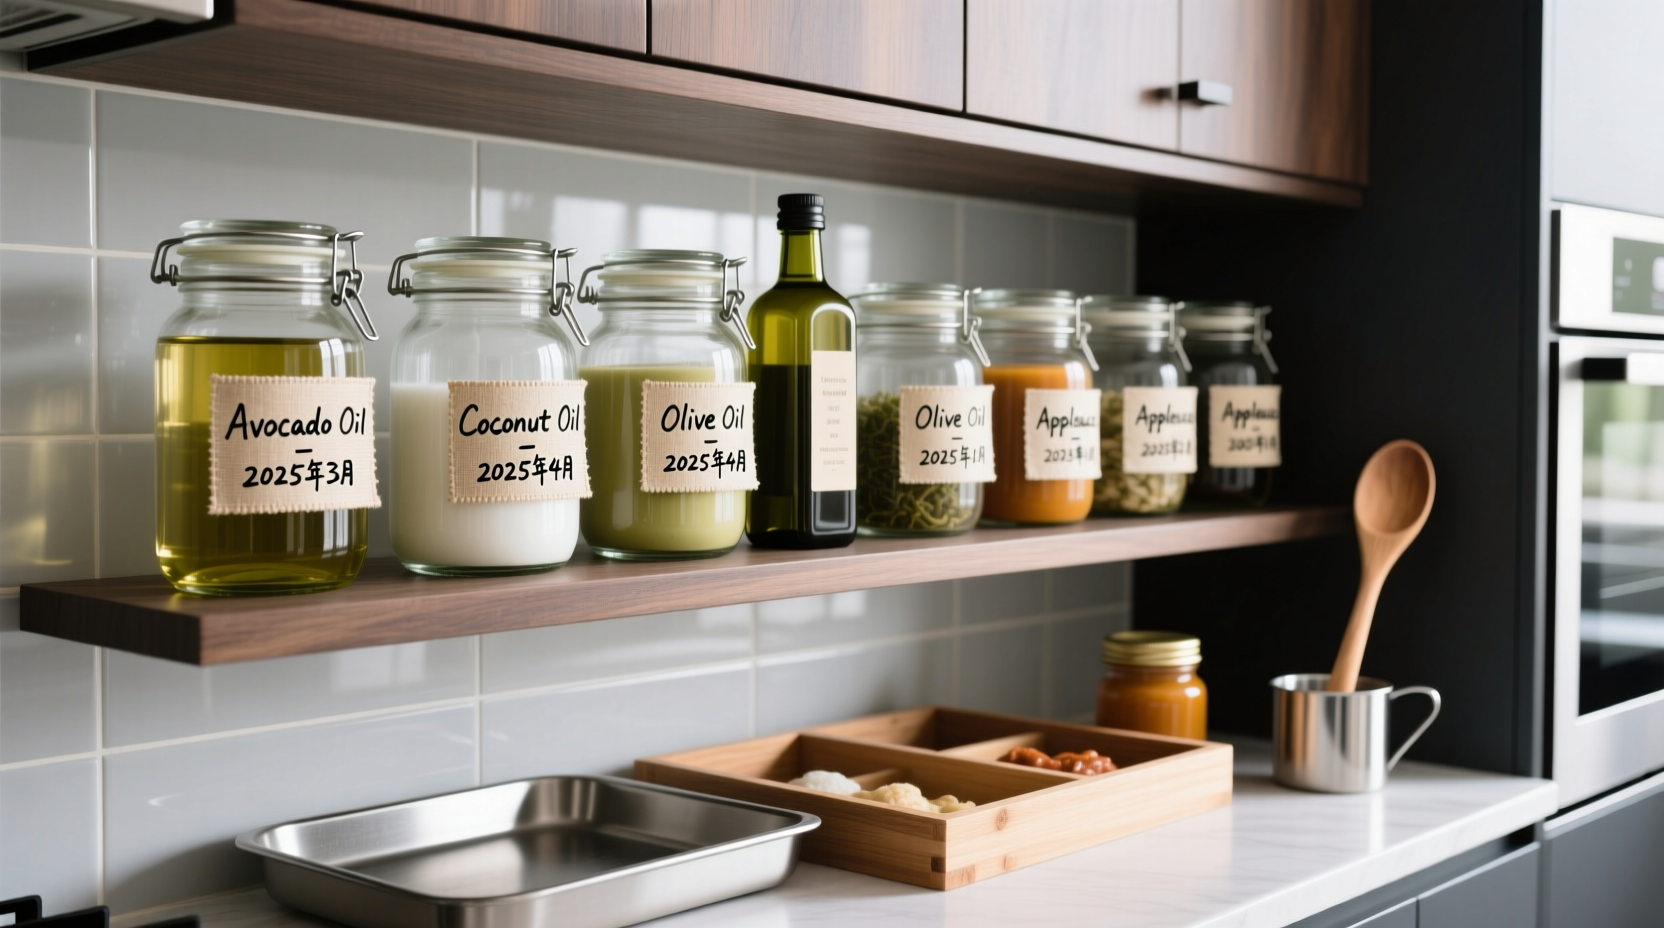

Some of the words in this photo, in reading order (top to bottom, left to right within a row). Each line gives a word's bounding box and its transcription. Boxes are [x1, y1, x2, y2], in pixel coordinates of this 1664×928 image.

[225, 403, 332, 440] Avocado
[339, 406, 366, 435] Oil
[459, 403, 551, 437] Coconut
[558, 404, 580, 432] Oil
[661, 403, 716, 432] Olive
[722, 404, 744, 430] Oil
[915, 404, 962, 430] Olive
[967, 404, 985, 427] Oil
[242, 459, 353, 492] 2025年3月
[477, 453, 573, 486] 2025年4月
[663, 448, 746, 479] 2025年4月
